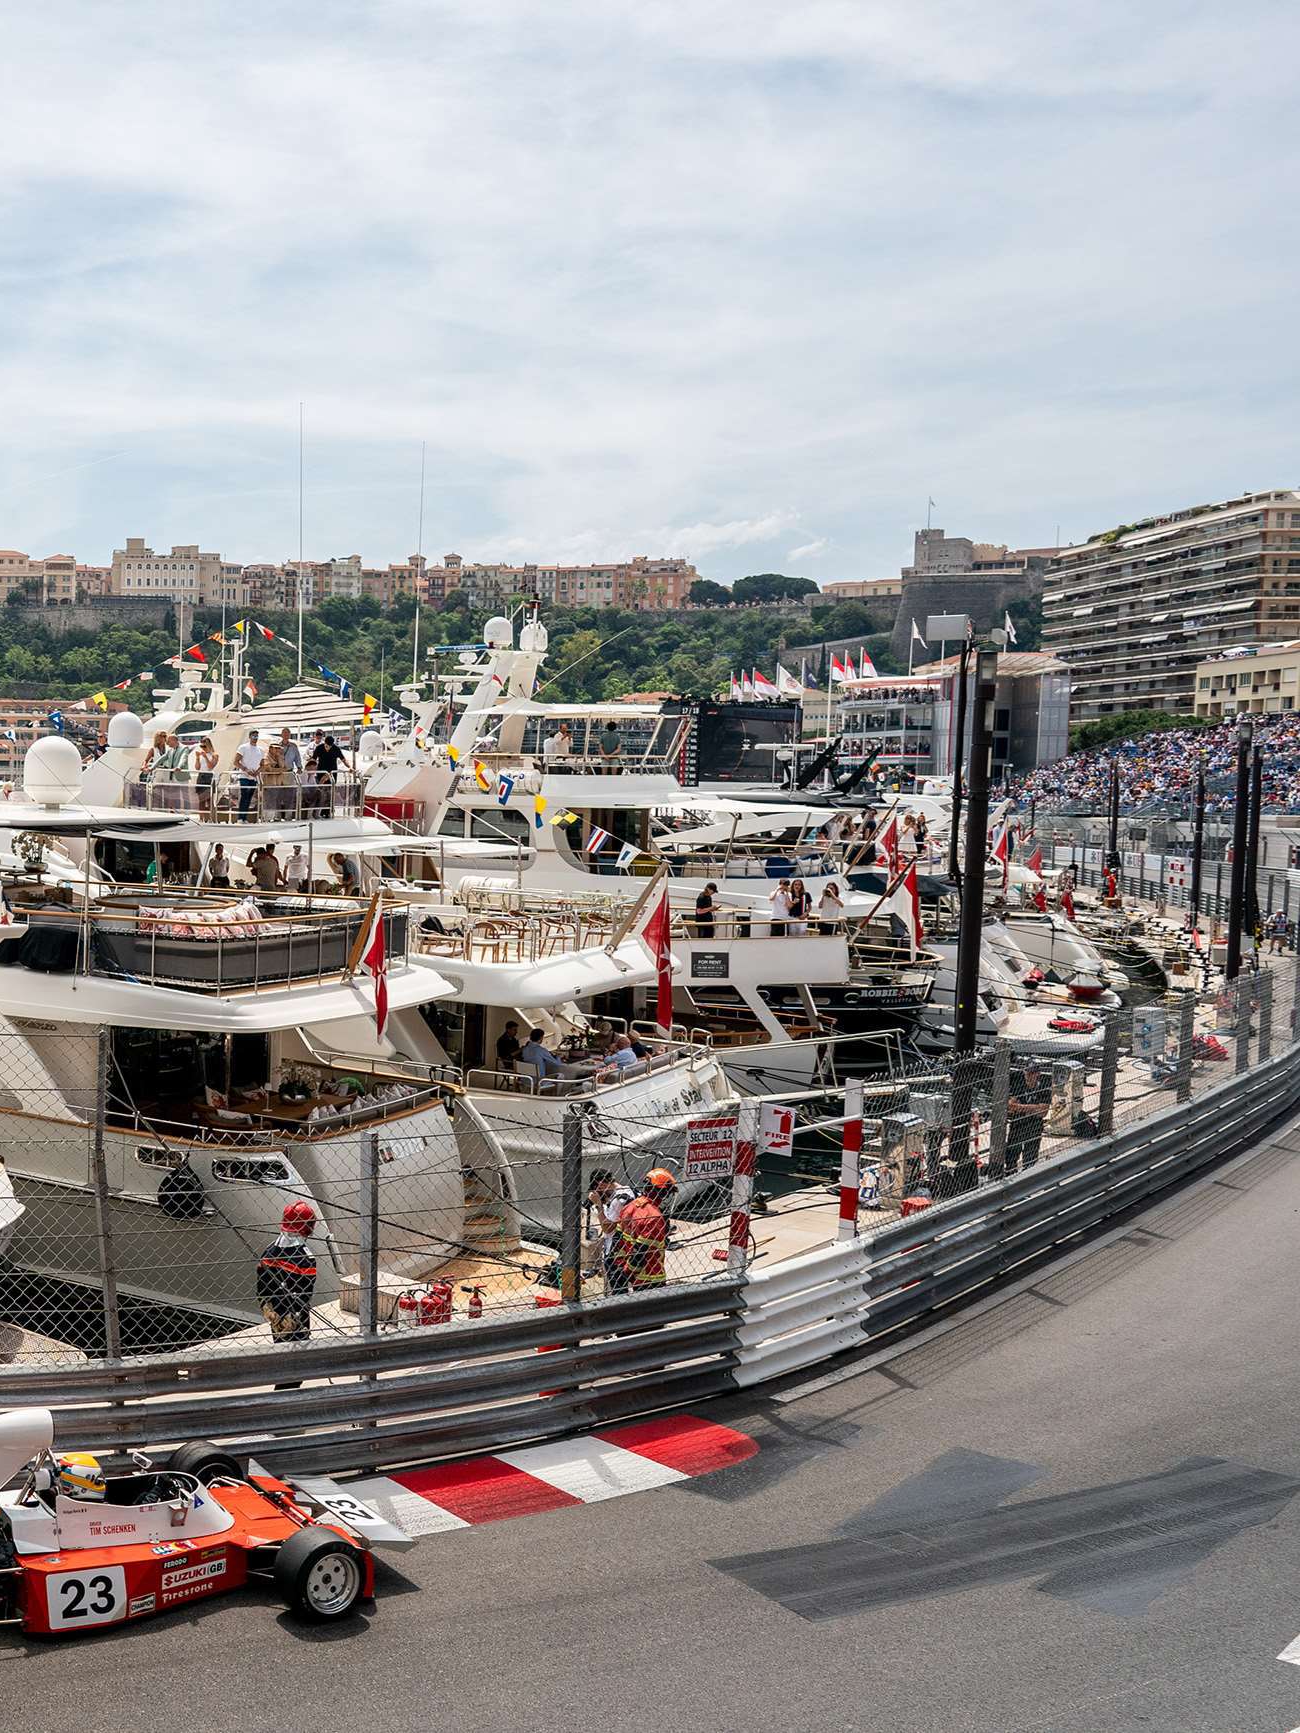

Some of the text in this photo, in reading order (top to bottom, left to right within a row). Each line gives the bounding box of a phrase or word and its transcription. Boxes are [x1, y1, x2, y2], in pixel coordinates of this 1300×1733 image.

[860, 989, 898, 998] ROBBIE
[690, 1129, 733, 1142] SECTEUR 12
[765, 1131, 790, 1141] FIRE
[689, 1146, 731, 1160] INTERVENTION
[688, 1160, 728, 1174] 12 ALPHA
[324, 1499, 375, 1521] 23
[89, 1524, 136, 1536] TIM SCHENKEN
[163, 1557, 188, 1569] FERODO
[60, 1575, 116, 1620] 23
[162, 1581, 213, 1604] Firestone
